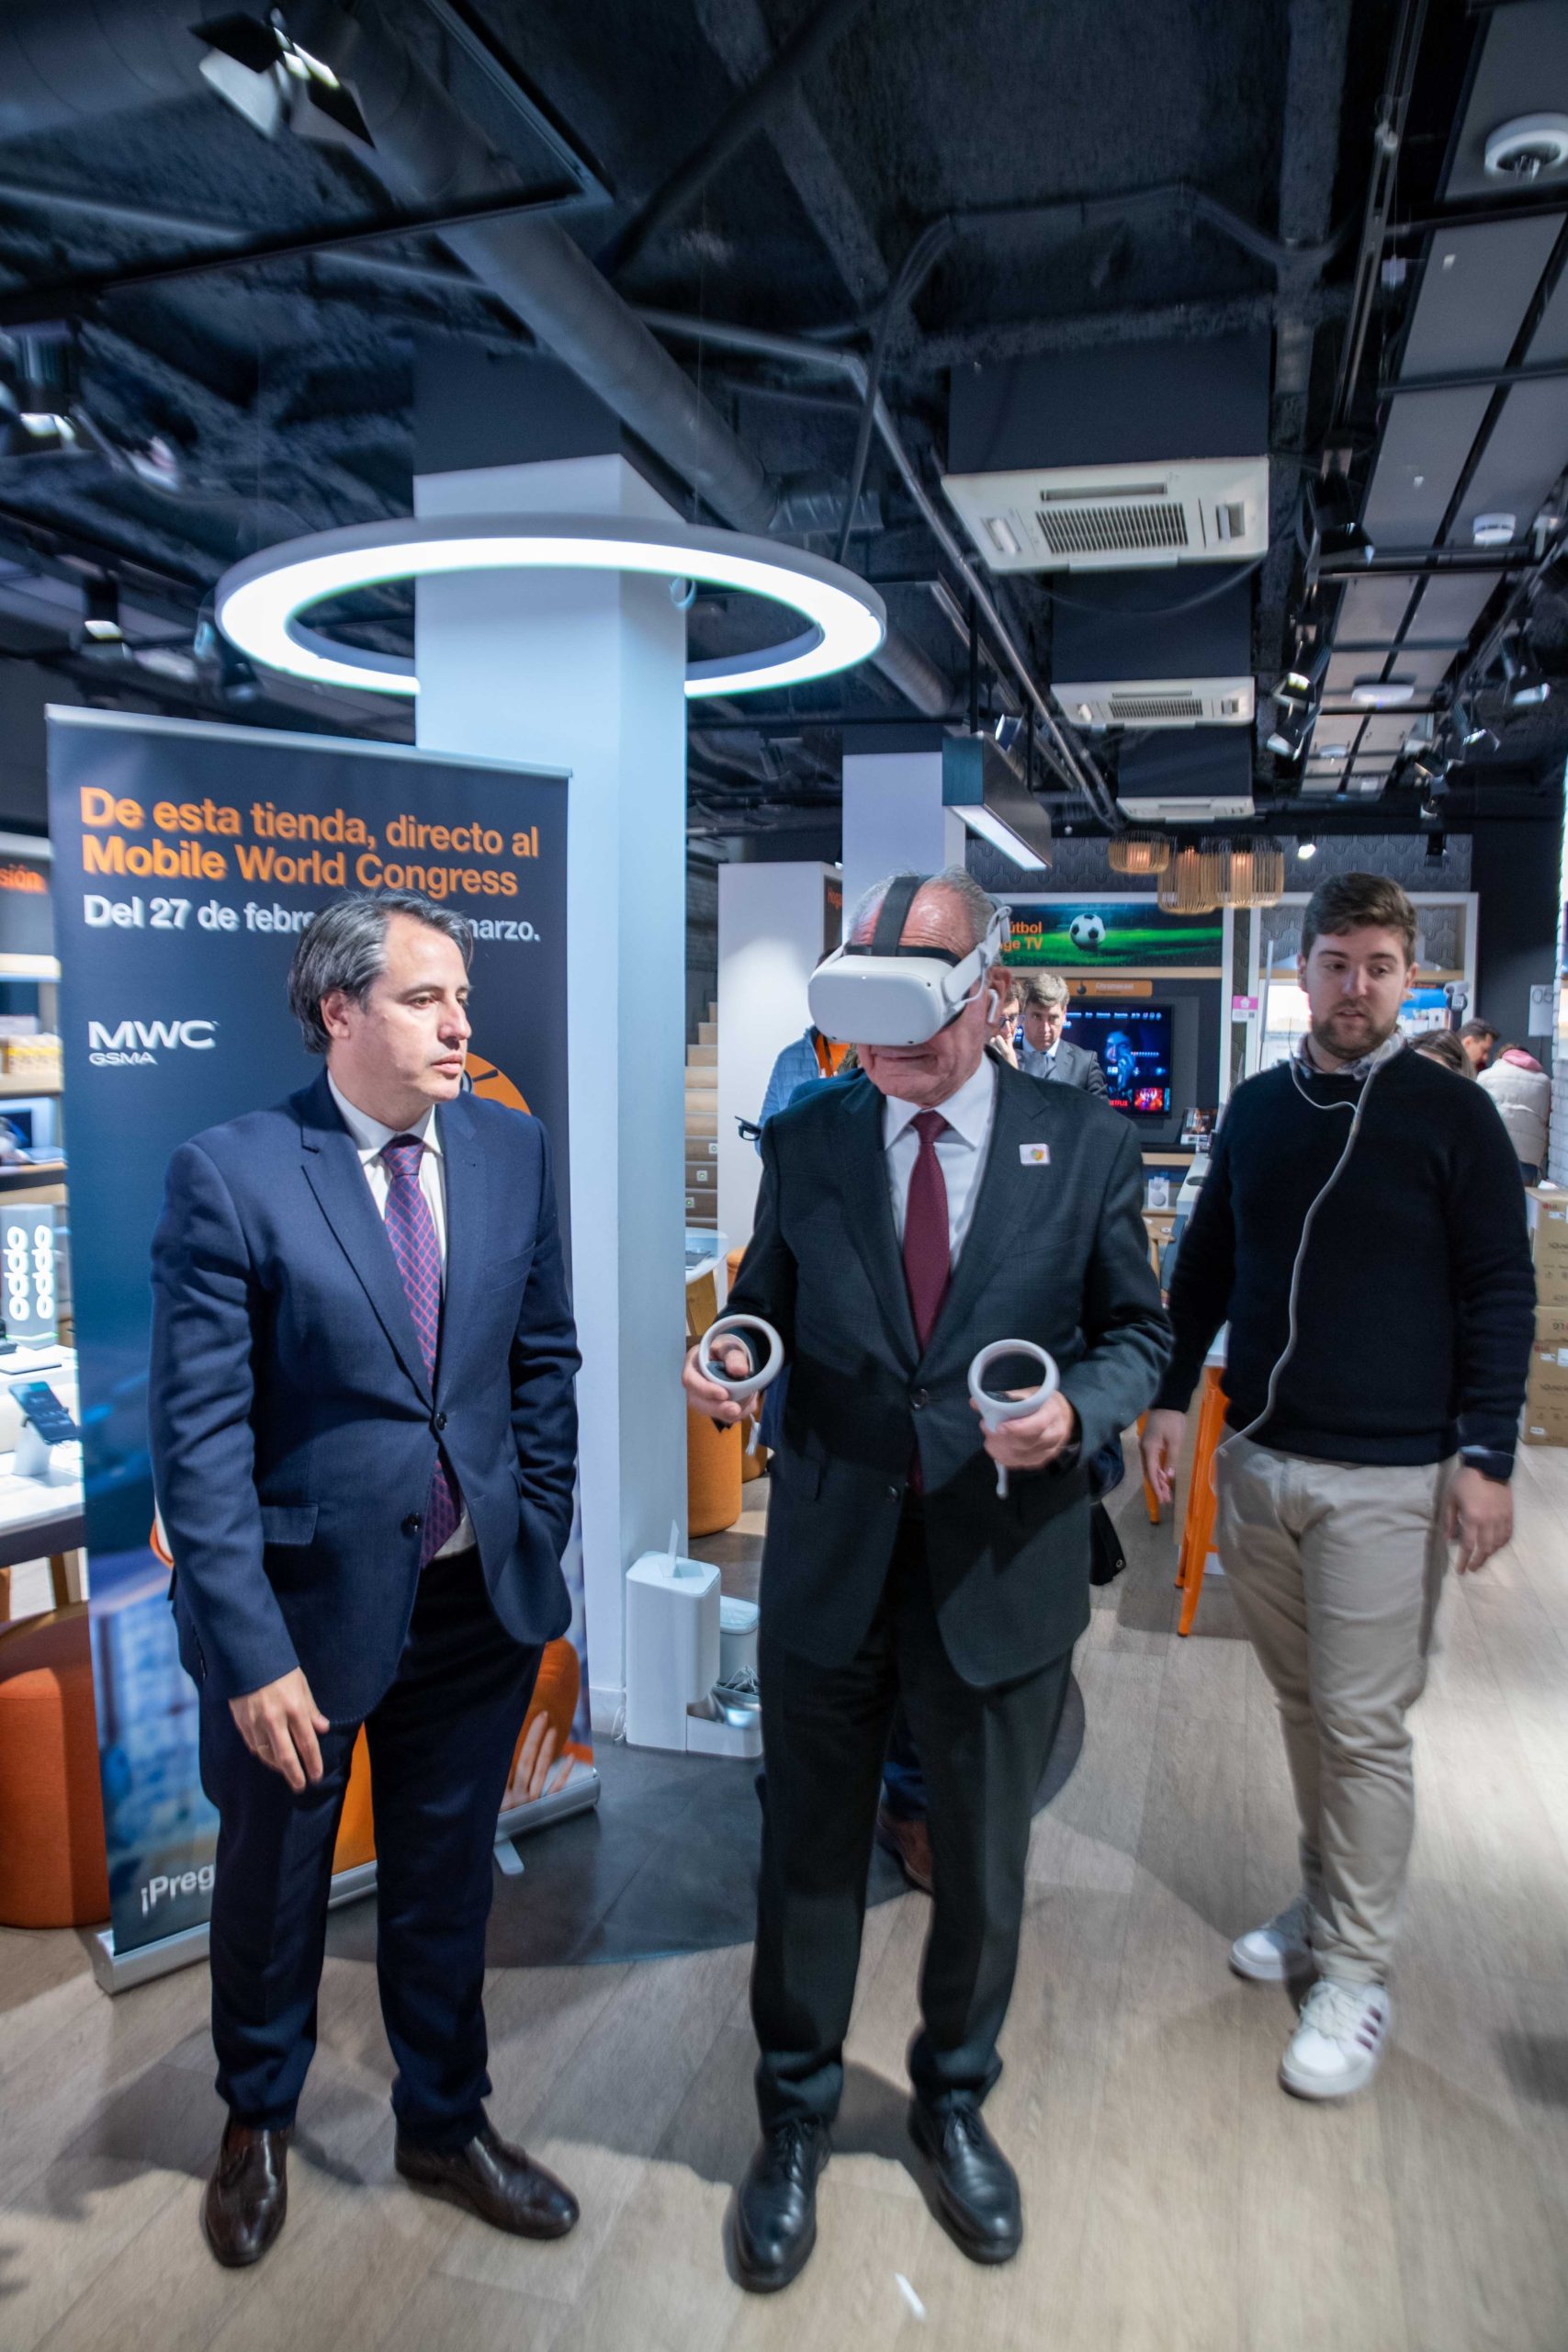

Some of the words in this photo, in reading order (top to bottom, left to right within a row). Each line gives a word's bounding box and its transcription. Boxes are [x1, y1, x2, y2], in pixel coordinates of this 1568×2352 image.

[80, 786, 145, 830] De
[152, 798, 243, 837] esta
[250, 801, 377, 852] tienda,
[386, 814, 504, 856] directo
[512, 826, 540, 859] al
[82, 834, 228, 880] Mobile
[234, 843, 346, 888] World
[355, 853, 520, 900] Congress
[83, 894, 145, 929] Del
[149, 897, 193, 930] 27
[197, 899, 241, 932] de
[1009, 921, 1042, 934] útbol
[1024, 936, 1043, 950] TV
[88, 1020, 217, 1050] MWC
[89, 1052, 158, 1067] GSMA
[141, 1864, 216, 1918] ¡Preg
